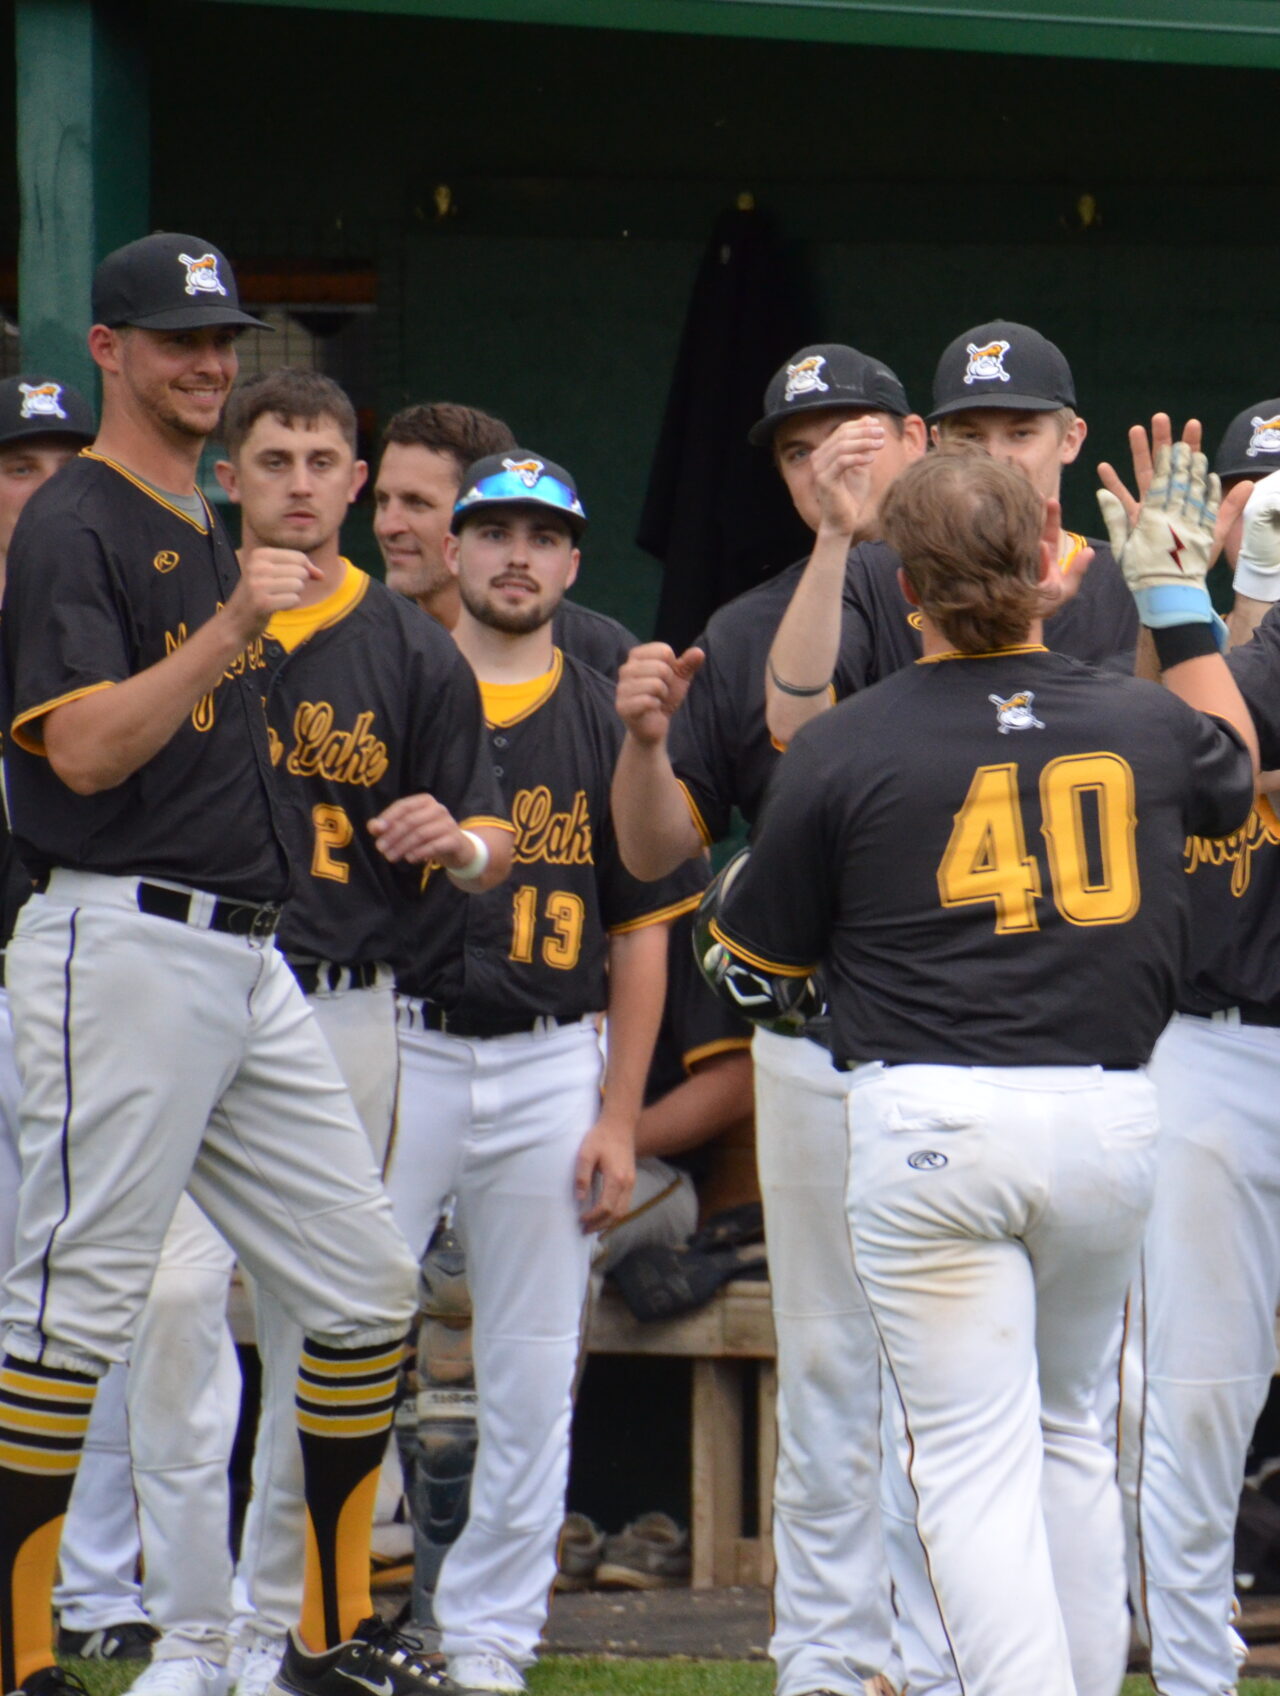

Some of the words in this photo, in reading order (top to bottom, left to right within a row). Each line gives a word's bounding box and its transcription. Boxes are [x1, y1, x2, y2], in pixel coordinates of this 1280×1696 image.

[287, 701, 389, 787] Lake
[311, 803, 354, 884] 2
[511, 785, 594, 865] Lak
[937, 751, 1140, 934] 40
[509, 886, 585, 970] 13
